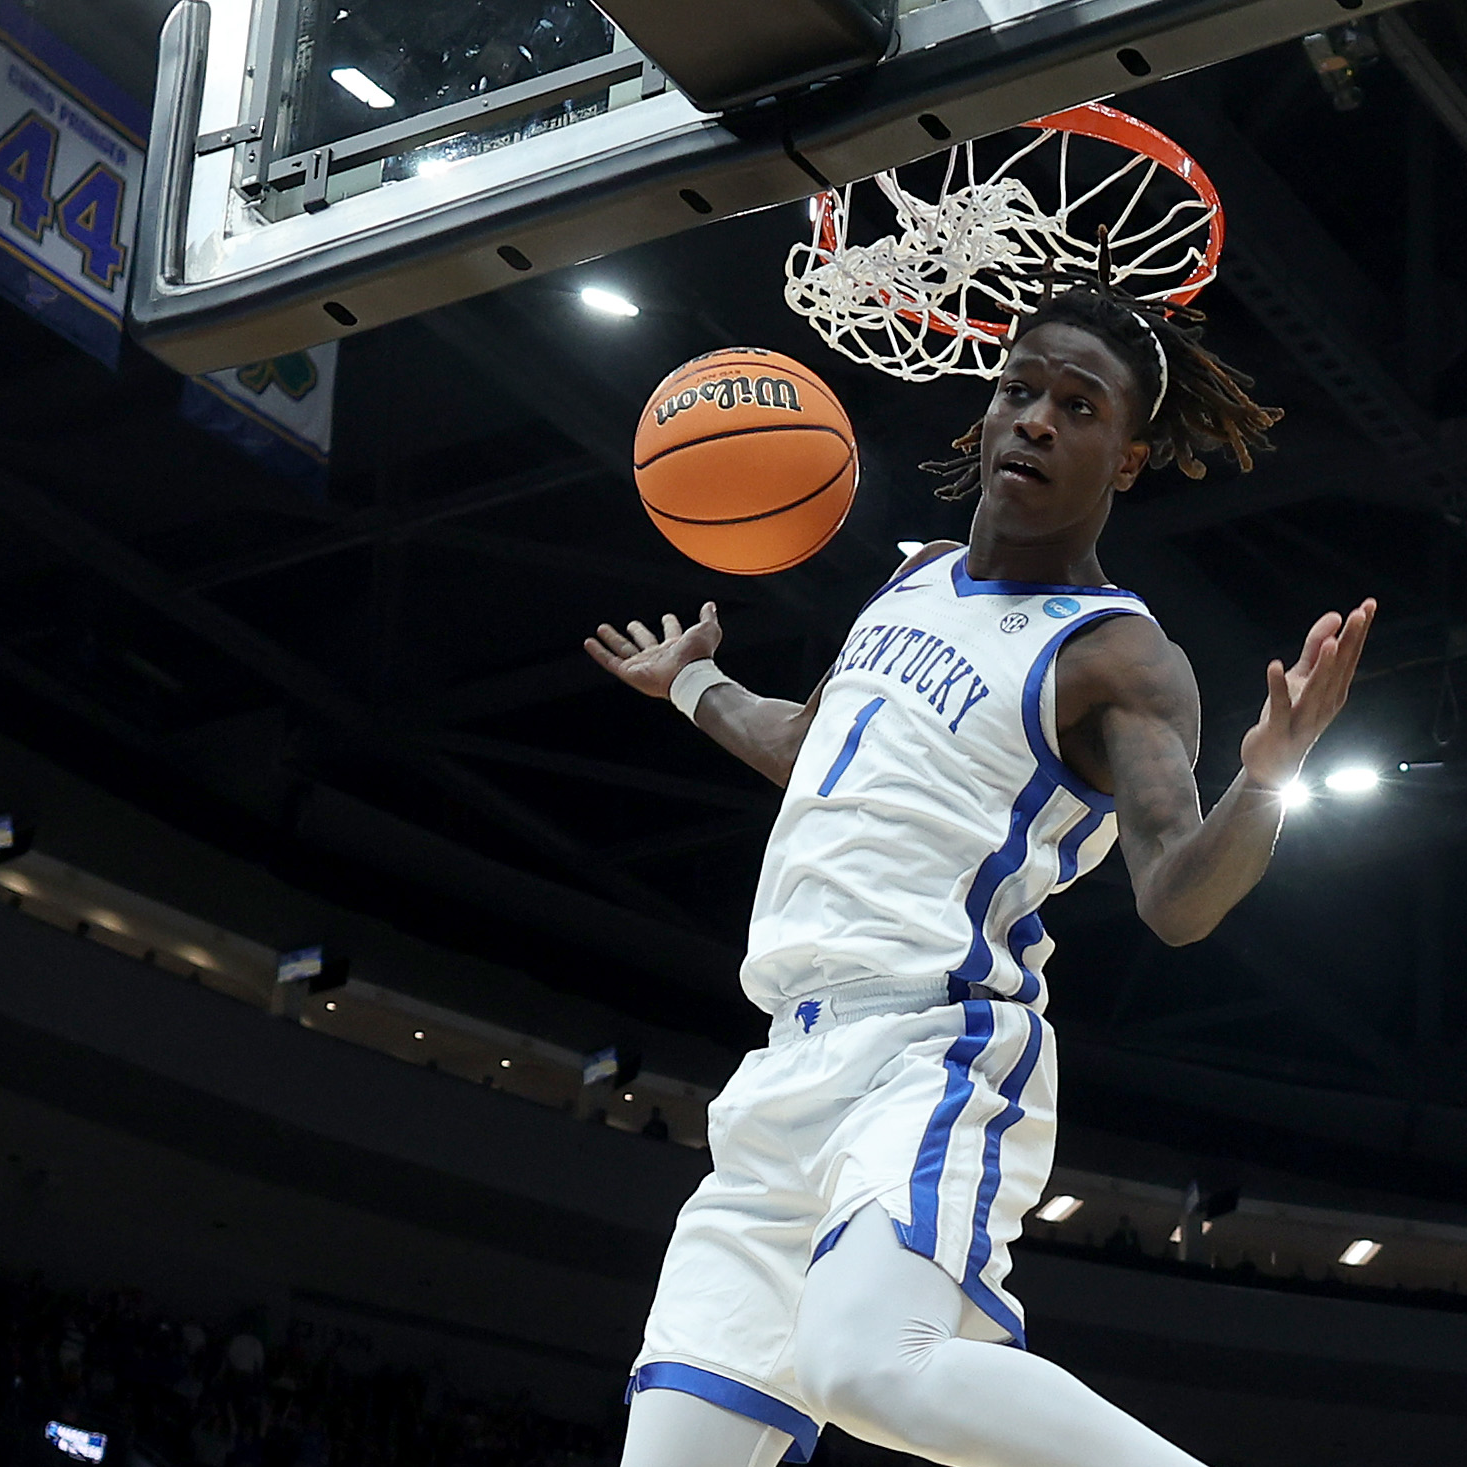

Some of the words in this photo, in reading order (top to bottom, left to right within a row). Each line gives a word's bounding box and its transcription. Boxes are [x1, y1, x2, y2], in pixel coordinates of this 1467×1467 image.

[653, 375, 804, 427] Wilson
[999, 612, 1029, 633] SEC
[831, 624, 990, 736] KENTUCKY
[817, 696, 887, 798] 1
